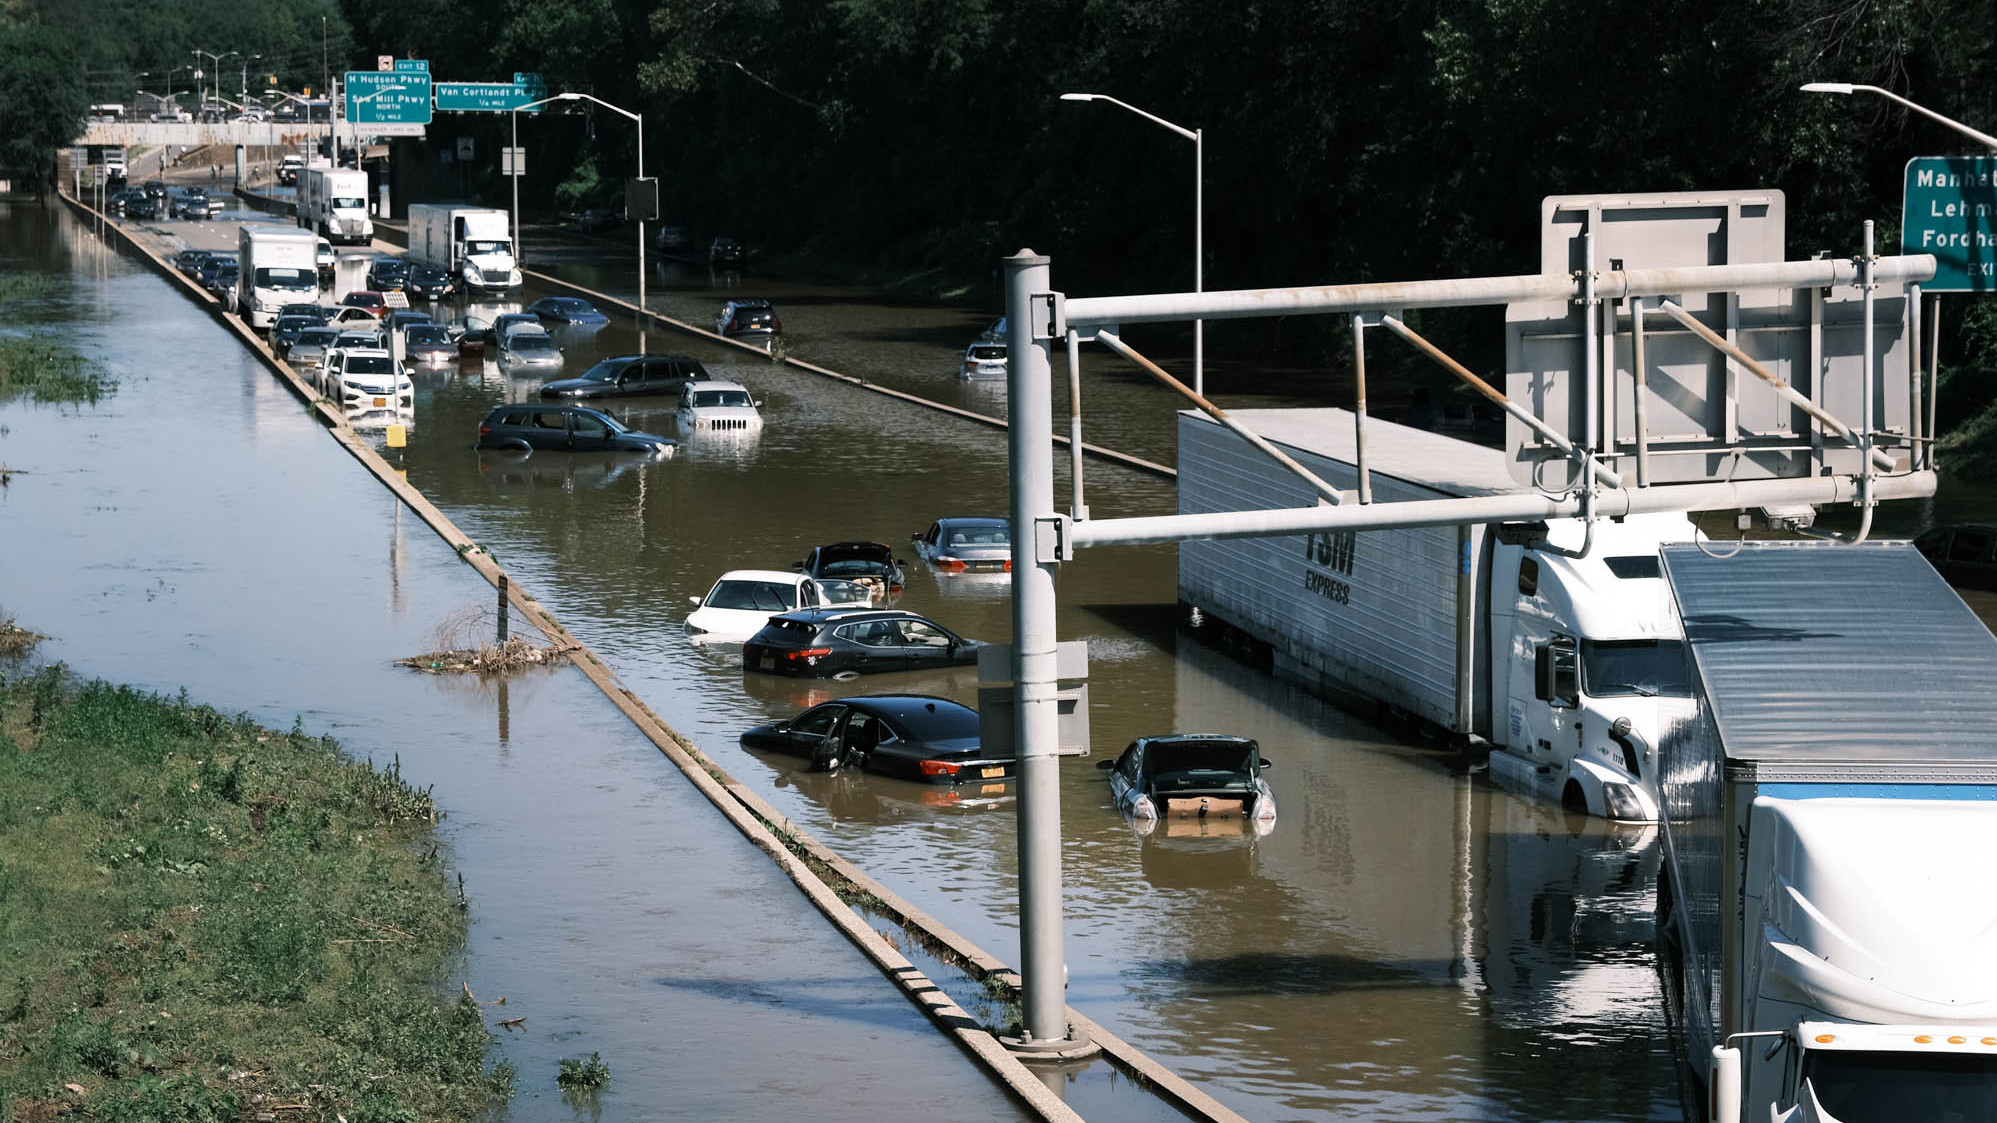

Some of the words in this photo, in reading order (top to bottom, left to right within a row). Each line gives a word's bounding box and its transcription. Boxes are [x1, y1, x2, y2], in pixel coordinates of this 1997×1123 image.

[349, 75, 356, 83] H
[361, 75, 396, 83] Hudson
[401, 75, 427, 85] Pkwy
[441, 88, 458, 96] Van
[463, 88, 510, 96] Cortlandt
[376, 94, 393, 103] Mill
[398, 94, 424, 105] Pkwy
[1305, 569, 1350, 606] EXPRESS
